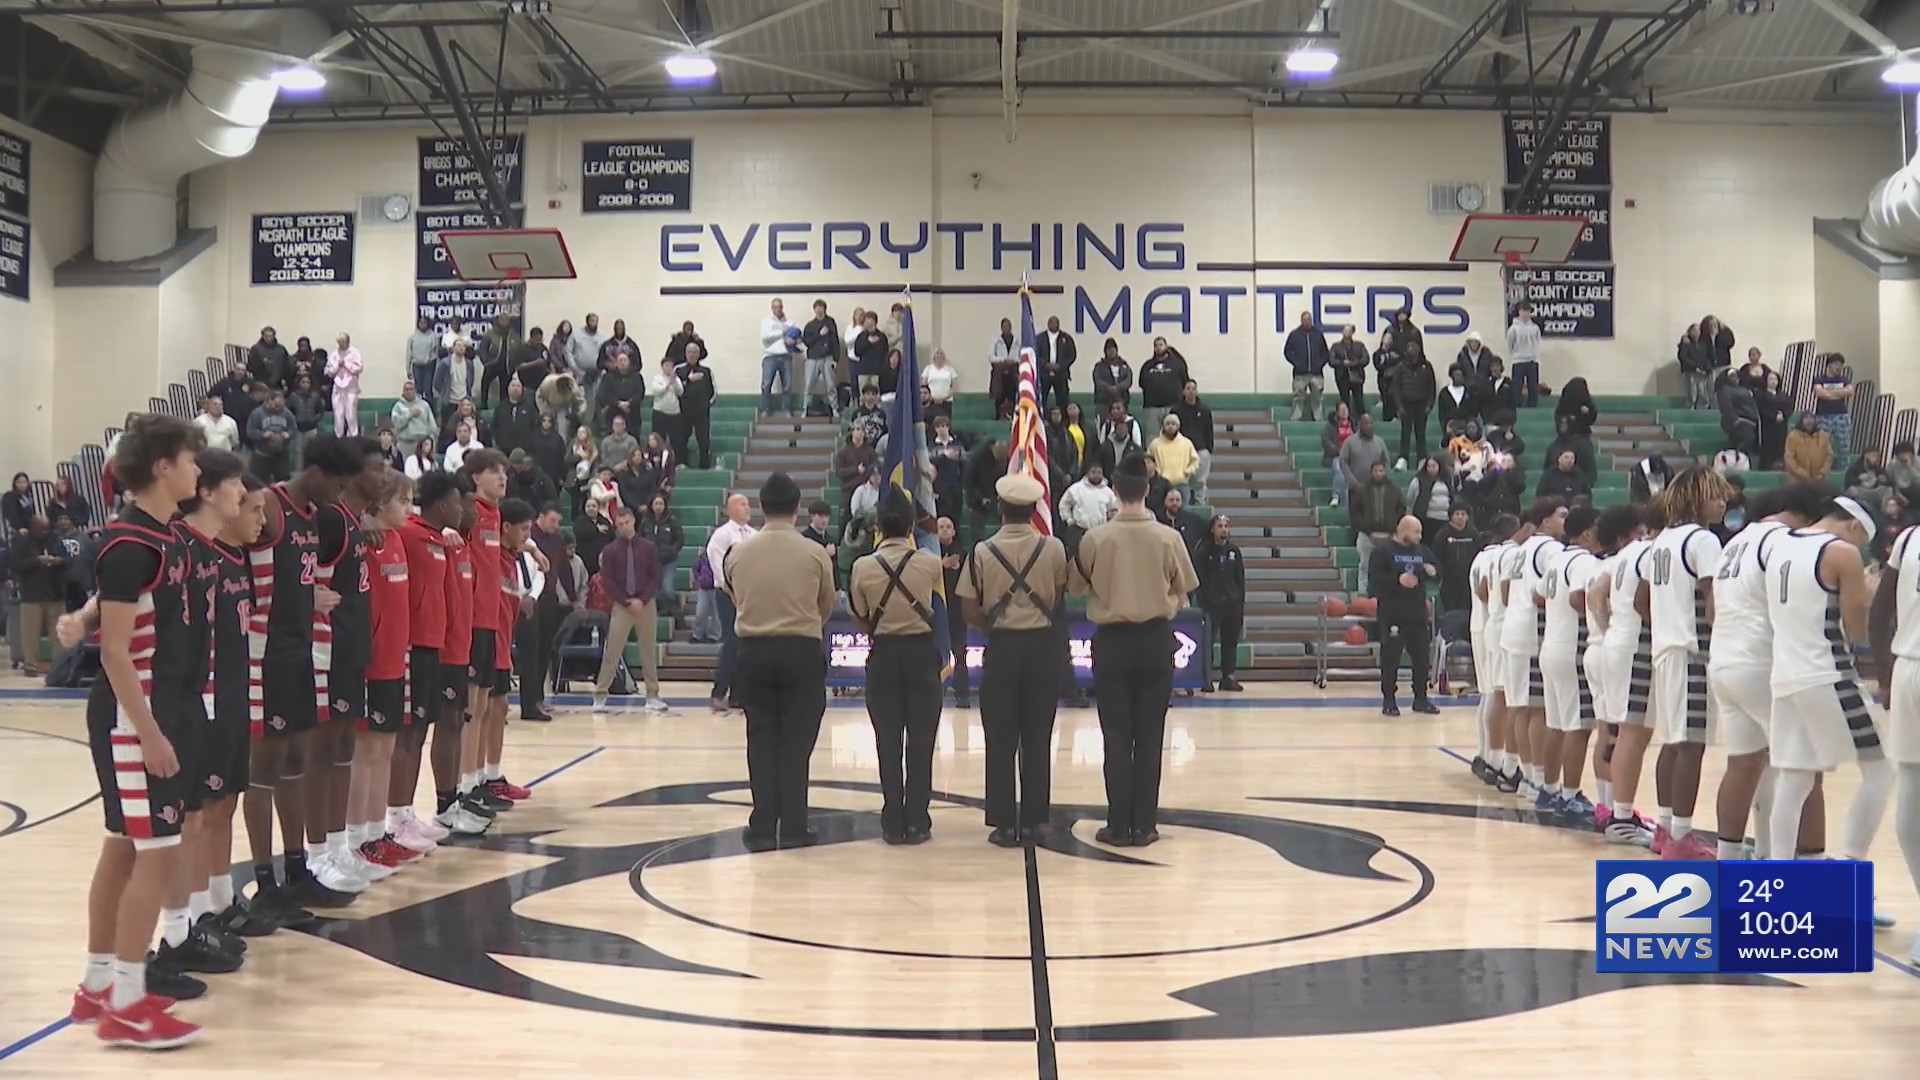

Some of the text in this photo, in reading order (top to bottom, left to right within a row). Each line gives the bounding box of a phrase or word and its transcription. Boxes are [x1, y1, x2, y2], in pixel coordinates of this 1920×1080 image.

[608, 145, 665, 158] FOOTBALL
[584, 159, 690, 176] LEAGUE CHAMPIONS
[1553, 194, 1596, 206] SOCCER
[262, 215, 346, 228] BOYS SOCCER
[426, 216, 460, 227] BOYS
[307, 227, 348, 241] LEAGUE
[274, 243, 332, 257] CHAMPIONS
[660, 221, 1185, 271] EVERYTHING
[283, 257, 322, 269] 12-2-4
[1554, 270, 1605, 282] SOCCER
[427, 289, 513, 302] BOYS SOCCER
[1572, 285, 1612, 300] LEAGUE
[1075, 285, 1470, 334] MATTERS
[1543, 320, 1578, 333] 2007
[1652, 547, 1672, 586] 10
[1717, 541, 1749, 580] 21
[1779, 560, 1791, 604] 1
